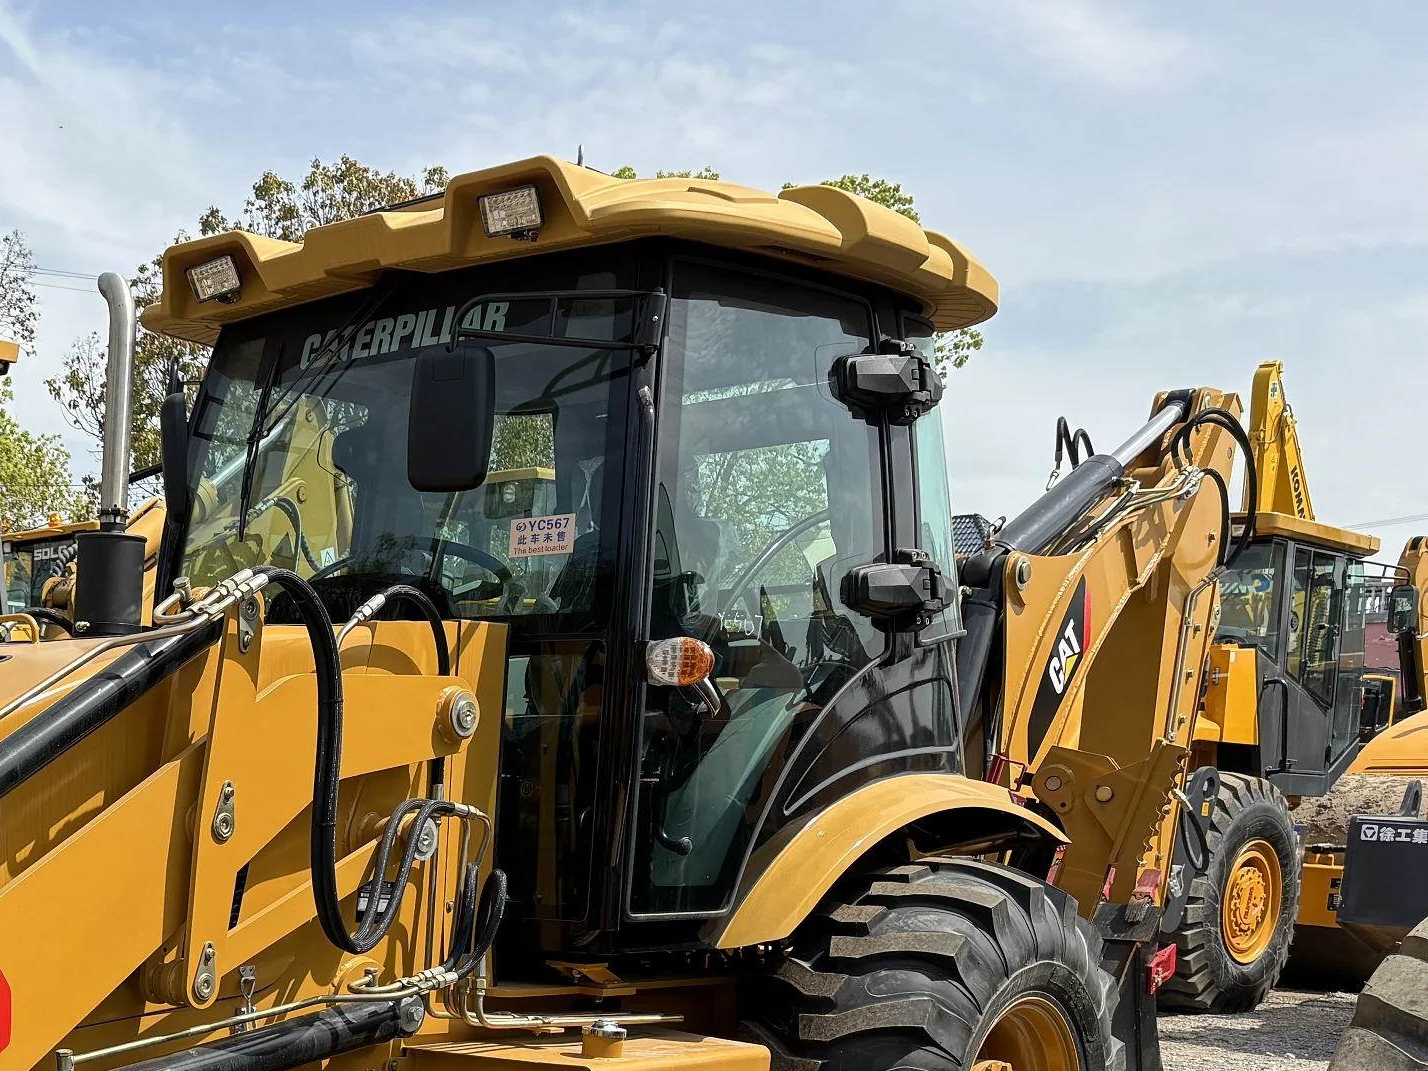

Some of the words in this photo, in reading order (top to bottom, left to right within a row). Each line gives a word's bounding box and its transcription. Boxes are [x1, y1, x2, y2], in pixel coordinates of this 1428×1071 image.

[529, 517, 570, 532] YC567
[517, 531, 566, 545] 此车未售
[514, 547, 527, 555] The
[528, 546, 544, 554] best
[545, 544, 569, 552] loader
[1049, 618, 1080, 694] CAT
